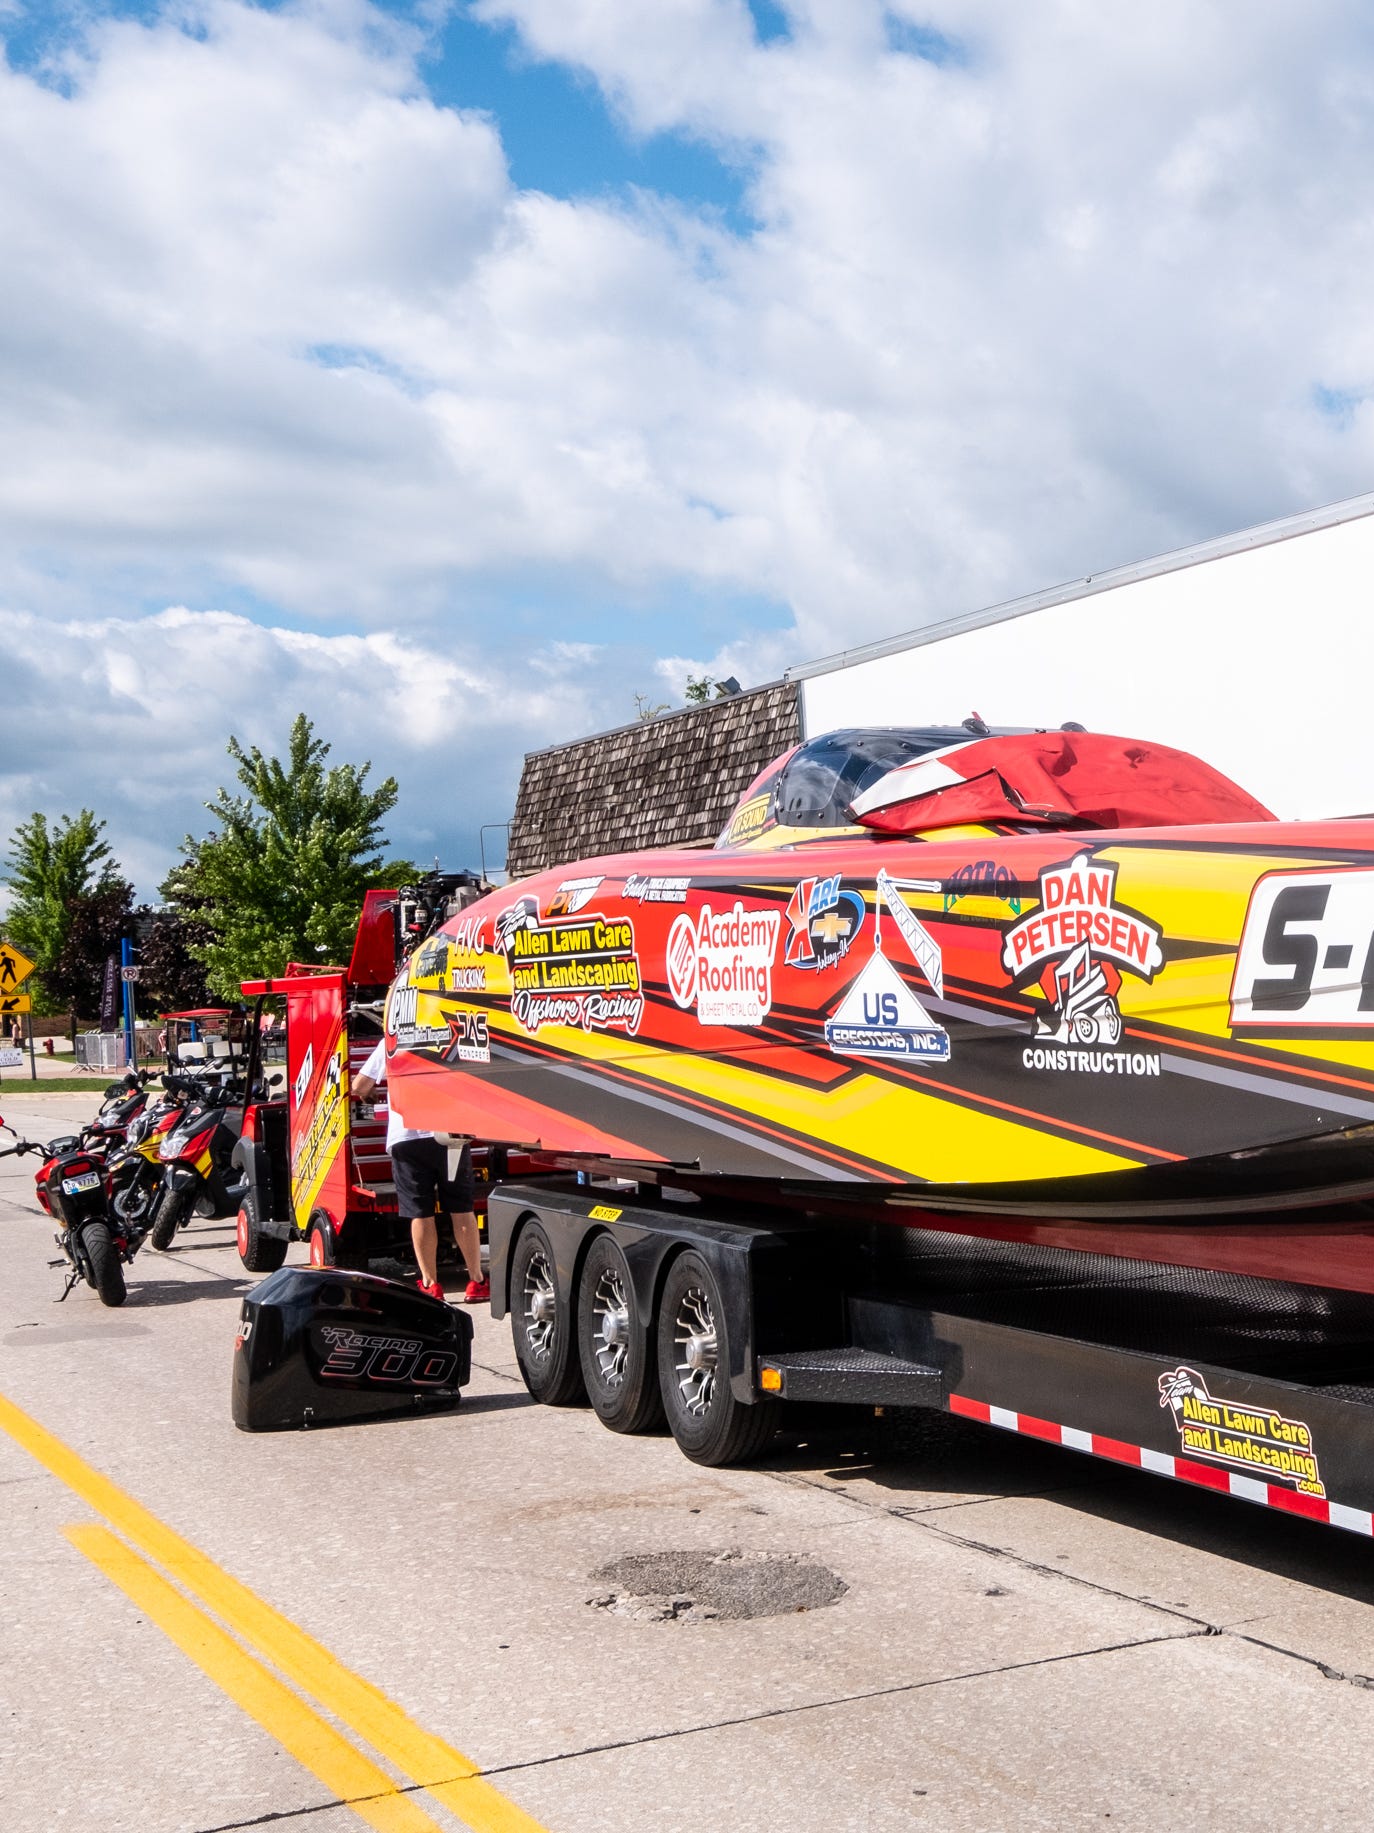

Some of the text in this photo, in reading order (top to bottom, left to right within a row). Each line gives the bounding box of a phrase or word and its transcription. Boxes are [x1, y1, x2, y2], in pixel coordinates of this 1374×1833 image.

[1045, 872, 1111, 911] DAN
[514, 920, 632, 956] Allen Lawn Care
[699, 909, 777, 958] Academy
[1011, 910, 1151, 966] PETERSEN
[452, 967, 486, 990] TRUCKING
[514, 956, 639, 992] and Landscaping
[699, 952, 769, 1007] Roofing
[513, 991, 642, 1029] Offshore Racing
[706, 1002, 725, 1016] SHEET
[727, 1002, 747, 1016] METAL
[863, 992, 899, 1026] US
[832, 1028, 941, 1053] ERECTORS, INC.
[1022, 1048, 1161, 1076] CONSTRUCTION
[322, 1326, 424, 1354] Racing
[320, 1347, 458, 1385] 300
[1183, 1396, 1310, 1446] Allen Lawn Care
[1184, 1427, 1317, 1481] and Landscaping
[1298, 1480, 1324, 1495] .com
